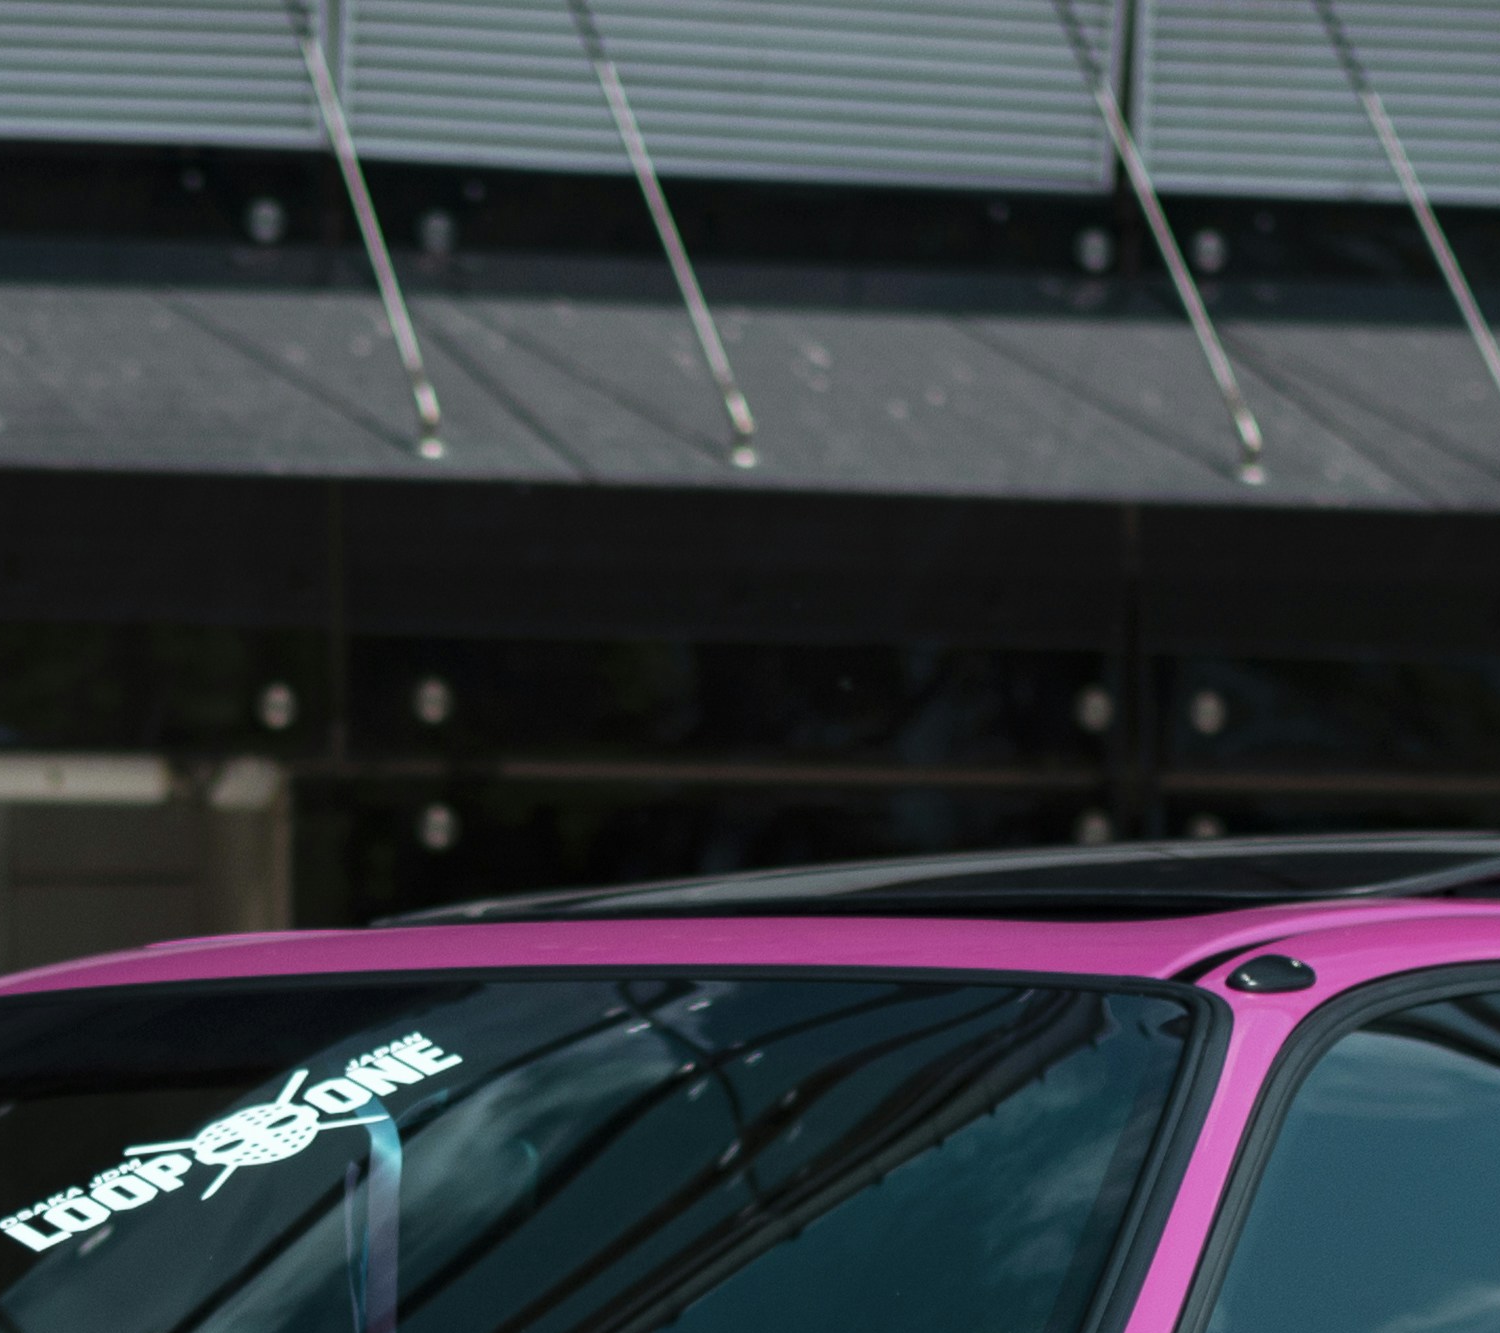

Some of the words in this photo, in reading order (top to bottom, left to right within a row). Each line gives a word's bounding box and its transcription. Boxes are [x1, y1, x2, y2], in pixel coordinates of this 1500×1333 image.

[345, 1031, 432, 1073] JAPAN
[2, 1153, 192, 1252] LOOP
[303, 1038, 462, 1114] ONE
[88, 1158, 142, 1191] JDM
